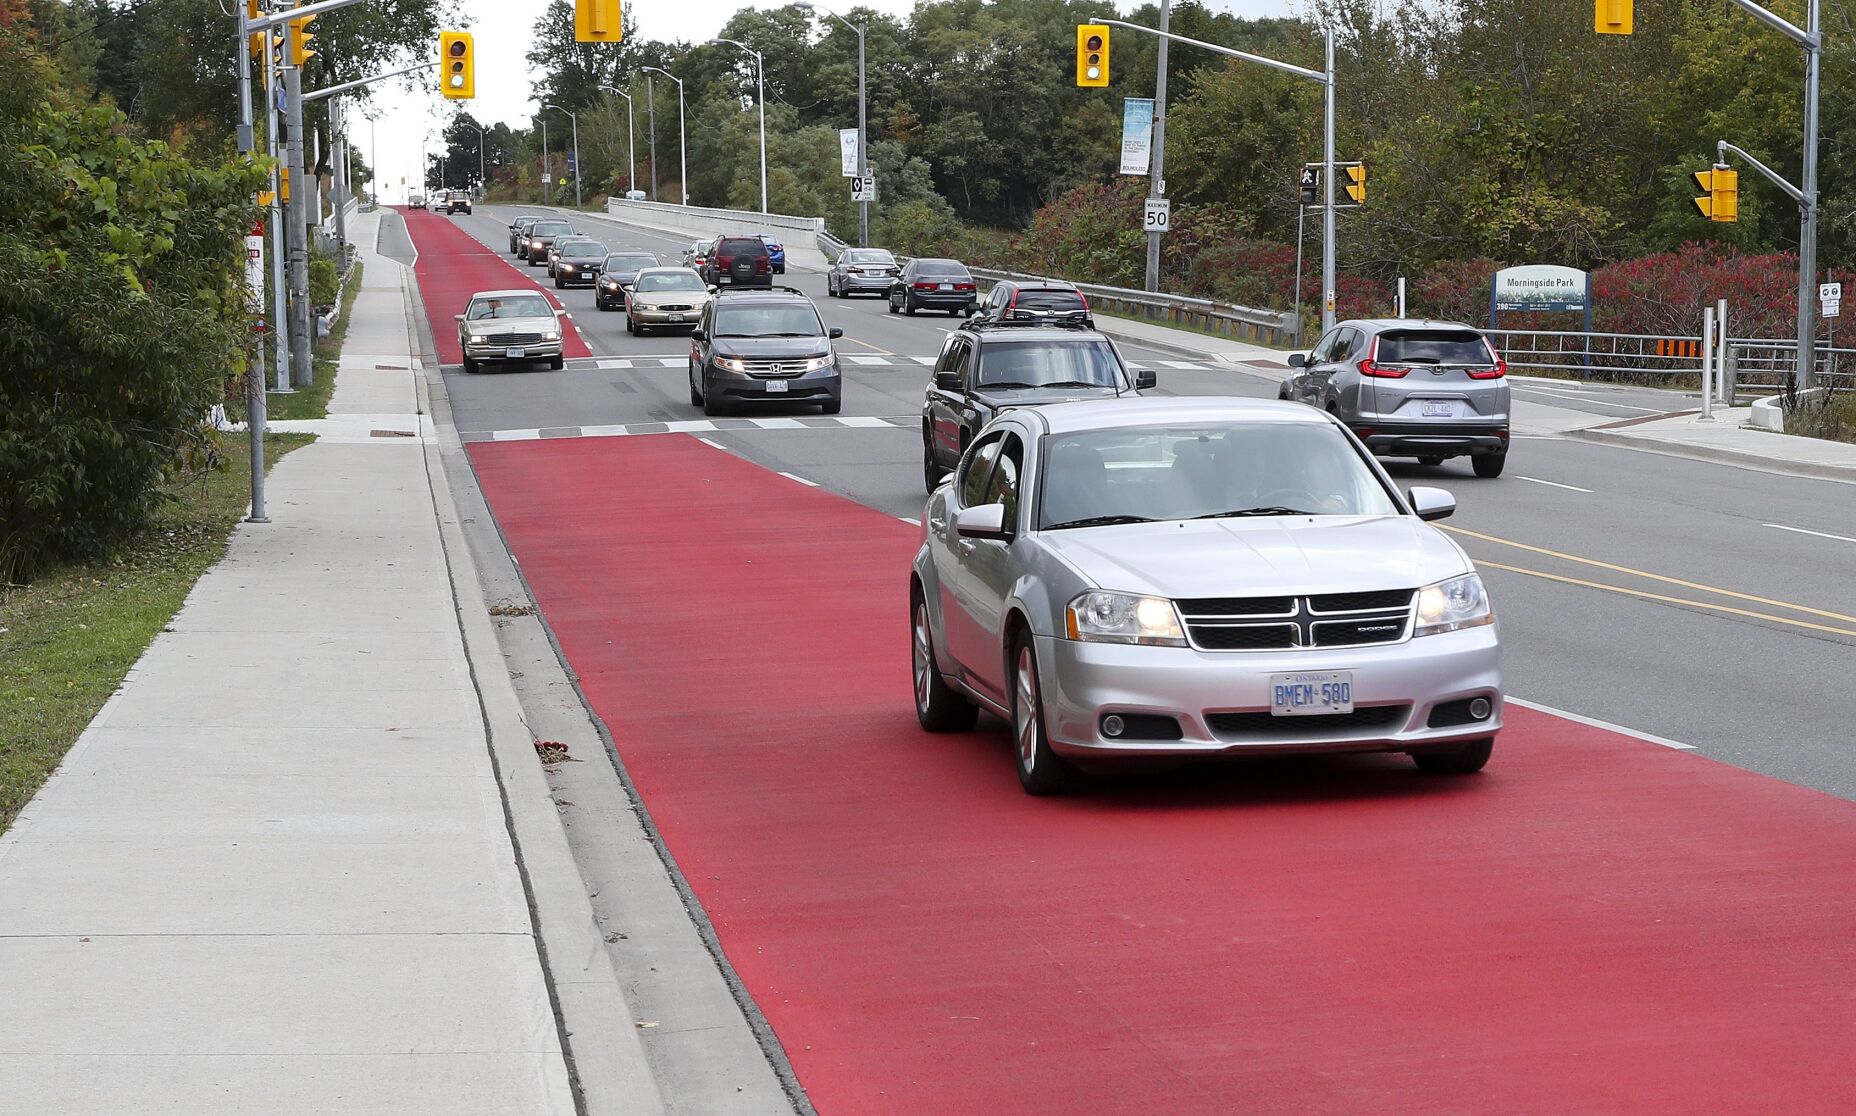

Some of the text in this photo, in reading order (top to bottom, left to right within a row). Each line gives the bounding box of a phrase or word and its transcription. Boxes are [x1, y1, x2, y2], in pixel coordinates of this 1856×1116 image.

[1147, 211, 1167, 226] 50
[1507, 278, 1574, 288] Morningside Park
[1275, 682, 1350, 706] BMEM 580
